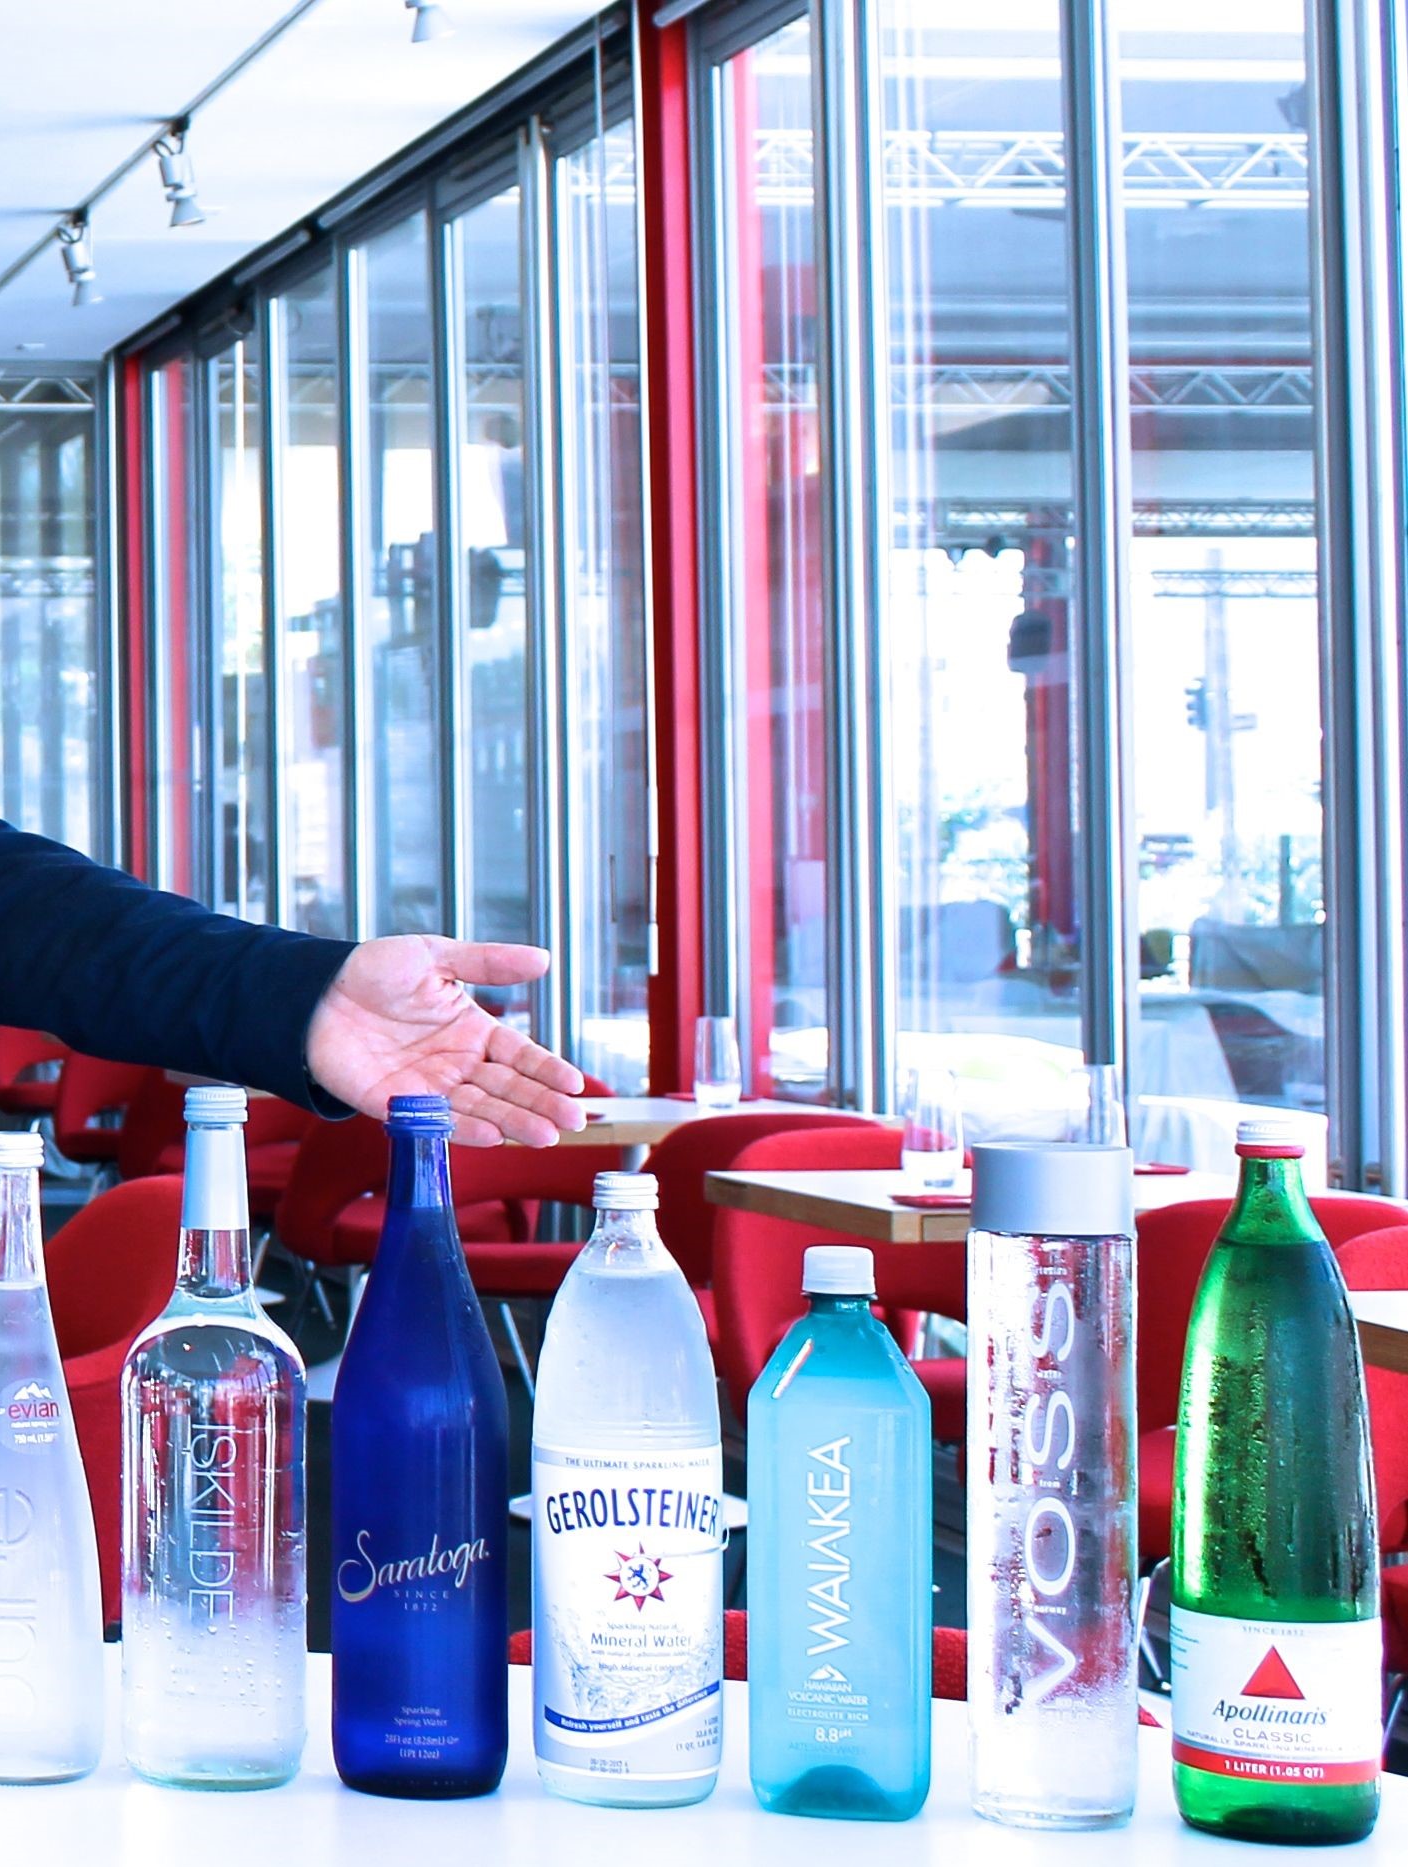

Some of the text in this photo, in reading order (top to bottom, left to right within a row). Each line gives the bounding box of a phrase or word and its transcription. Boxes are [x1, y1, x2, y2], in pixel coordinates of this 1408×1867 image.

[8, 1400, 60, 1419] evian
[565, 1457, 580, 1467] THE
[584, 1459, 628, 1469] ULTIMATE
[1025, 1282, 1076, 1701] VOSS
[546, 1487, 719, 1536] GEROLSTEINER
[189, 1424, 237, 1622] ISKILDE
[338, 1530, 485, 1603] Saratoga
[394, 1590, 450, 1599] SINCE
[404, 1602, 438, 1612] 1872
[590, 1632, 693, 1649] Mineral Water
[1213, 1699, 1327, 1725] Apollinaris
[625, 1716, 641, 1727] and
[1233, 1727, 1312, 1744] CLASSIC
[1234, 1761, 1266, 1774] LITER
[1270, 1764, 1300, 1777] (1.05
[1303, 1767, 1324, 1779] QT)
